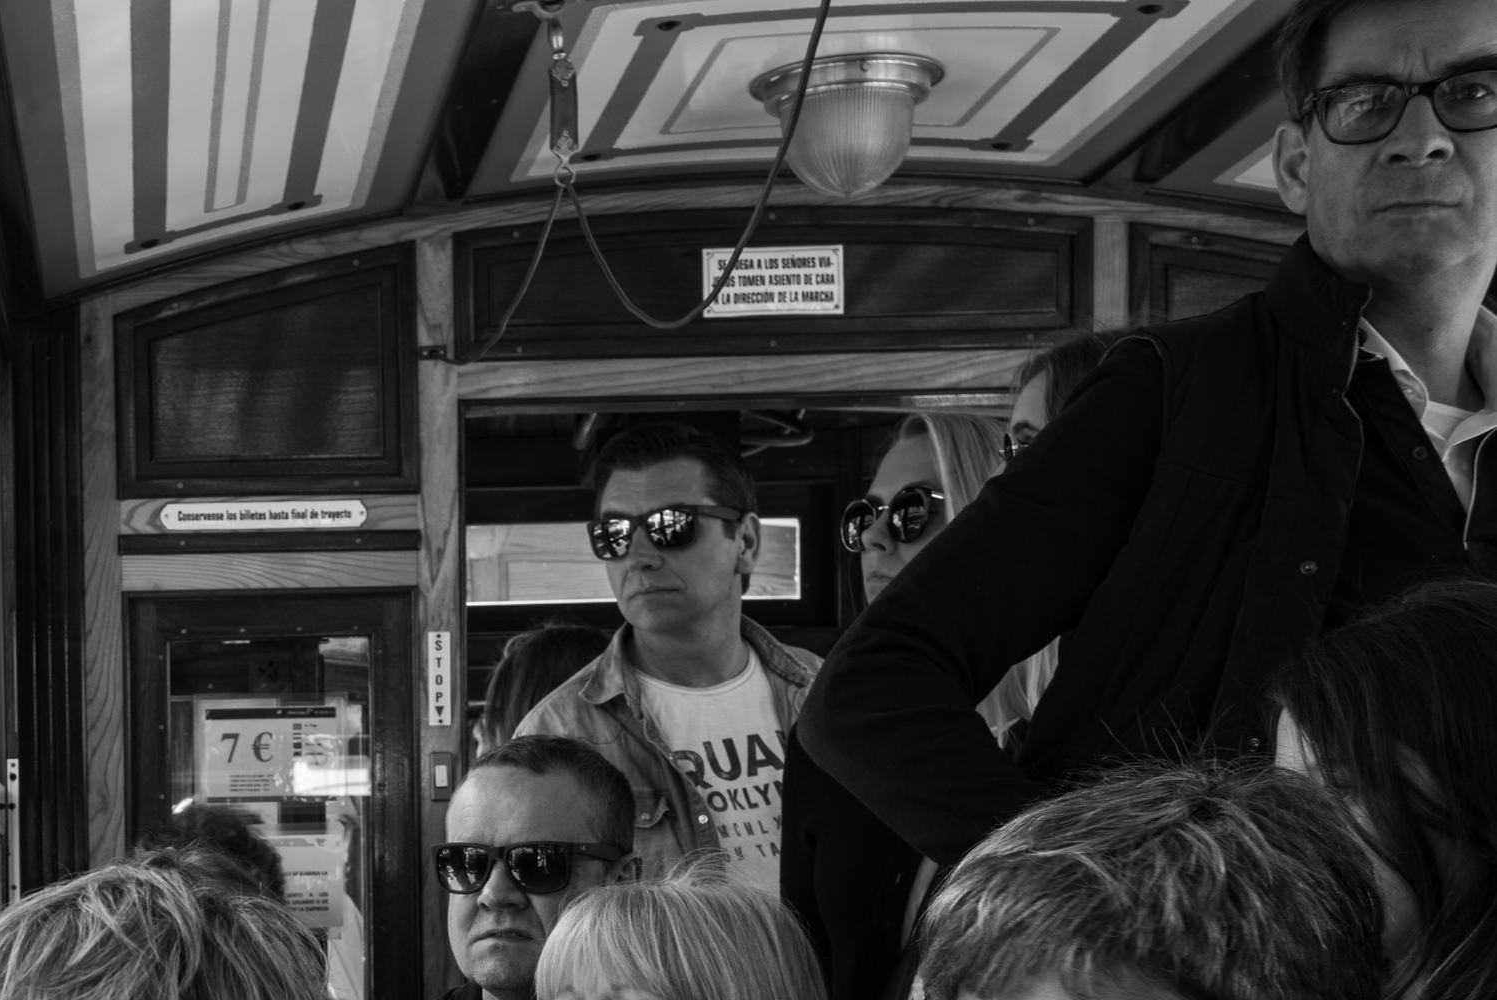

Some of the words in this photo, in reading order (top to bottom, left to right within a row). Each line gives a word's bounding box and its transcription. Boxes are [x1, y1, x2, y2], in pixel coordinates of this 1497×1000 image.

[734, 258, 754, 270] UEGA
[757, 258, 763, 270] A
[764, 258, 779, 270] LOS
[781, 254, 816, 269] SEÑORES
[818, 256, 835, 269] VIA-
[711, 275, 736, 288] JOS
[738, 275, 766, 287] TOMEN
[768, 273, 801, 286] ASIENTO
[803, 273, 814, 285] DE
[815, 273, 836, 285] CARA
[721, 292, 731, 305] LA
[733, 288, 775, 304] DIRECCIÓN
[777, 291, 787, 303] DE
[789, 291, 799, 303] LA
[802, 291, 835, 303] MARCHA
[178, 510, 224, 521] Conservense
[226, 509, 237, 521] los
[239, 509, 266, 520] billetes
[269, 509, 289, 520] hasta
[291, 508, 308, 520] final
[310, 508, 319, 519] de
[321, 508, 352, 521] trayecto
[434, 639, 444, 703] STOP
[221, 732, 241, 764] 7
[251, 731, 274, 763] €
